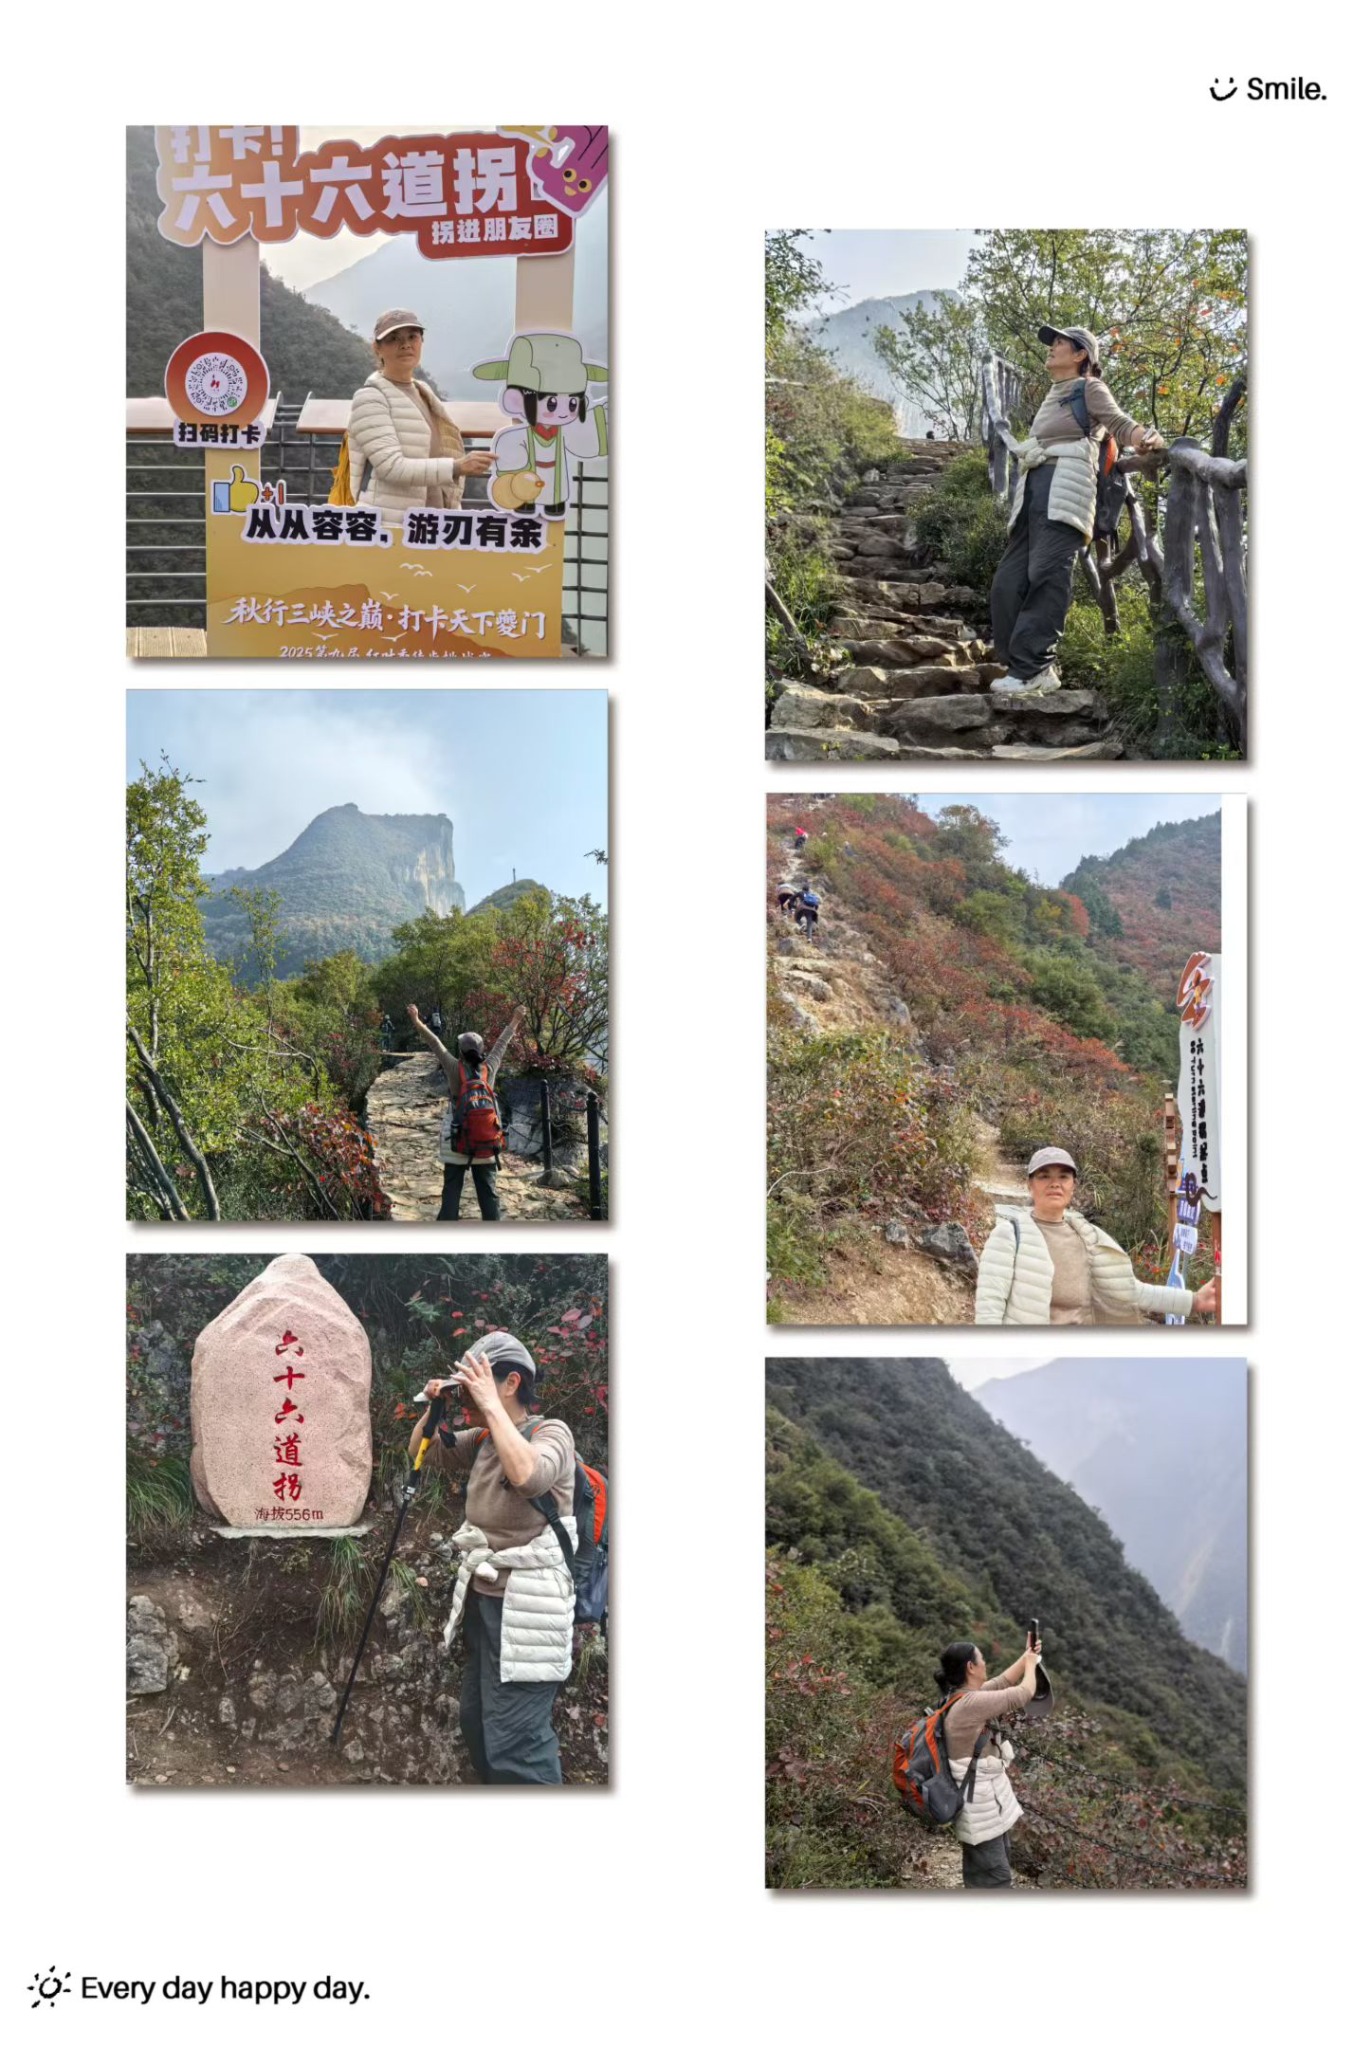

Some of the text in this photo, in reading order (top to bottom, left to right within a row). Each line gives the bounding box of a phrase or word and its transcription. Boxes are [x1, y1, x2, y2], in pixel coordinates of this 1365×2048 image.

[172, 146, 517, 232] 六十六道拐
[431, 213, 558, 246] 拐进朋友圈
[178, 422, 262, 445] 扫码打卡
[273, 1329, 305, 1501] 六十六道拐
[253, 1506, 325, 1521] 海拔556m
